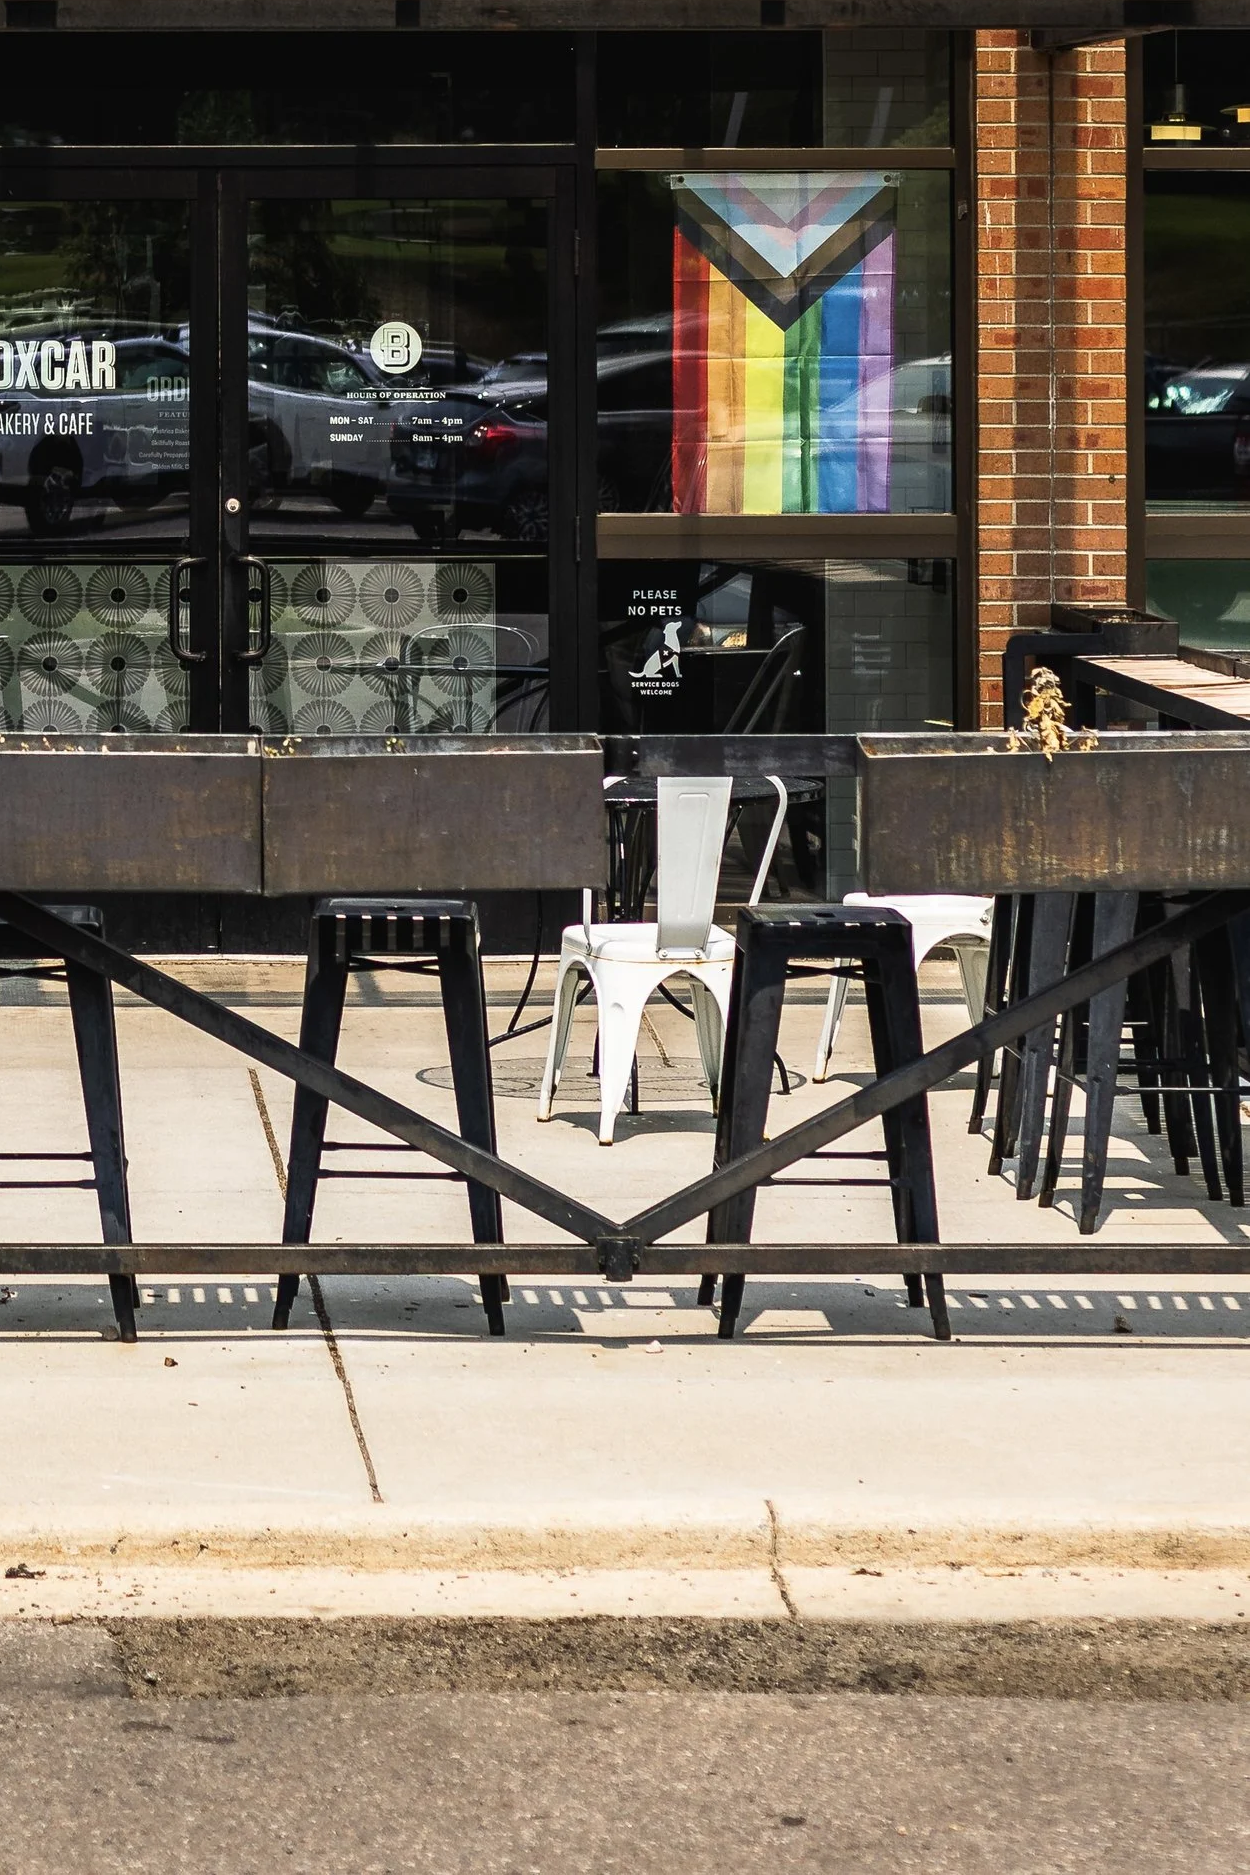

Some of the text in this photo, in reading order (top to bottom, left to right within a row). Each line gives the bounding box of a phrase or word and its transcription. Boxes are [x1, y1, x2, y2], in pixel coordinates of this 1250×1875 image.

[147, 376, 190, 402] ORD
[347, 391, 447, 399] HOURS OF OPERATION
[44, 413, 55, 435] &
[59, 413, 93, 435] CAFE
[330, 416, 351, 424] MON
[358, 416, 374, 424] SAT
[412, 416, 432, 424] 7am
[441, 416, 463, 426] 4pm
[330, 433, 363, 442] SUNDAY
[412, 434, 432, 442] 8am
[441, 434, 463, 444] 4pm
[633, 590, 677, 599] PLEASE
[628, 606, 682, 616] NO PETS
